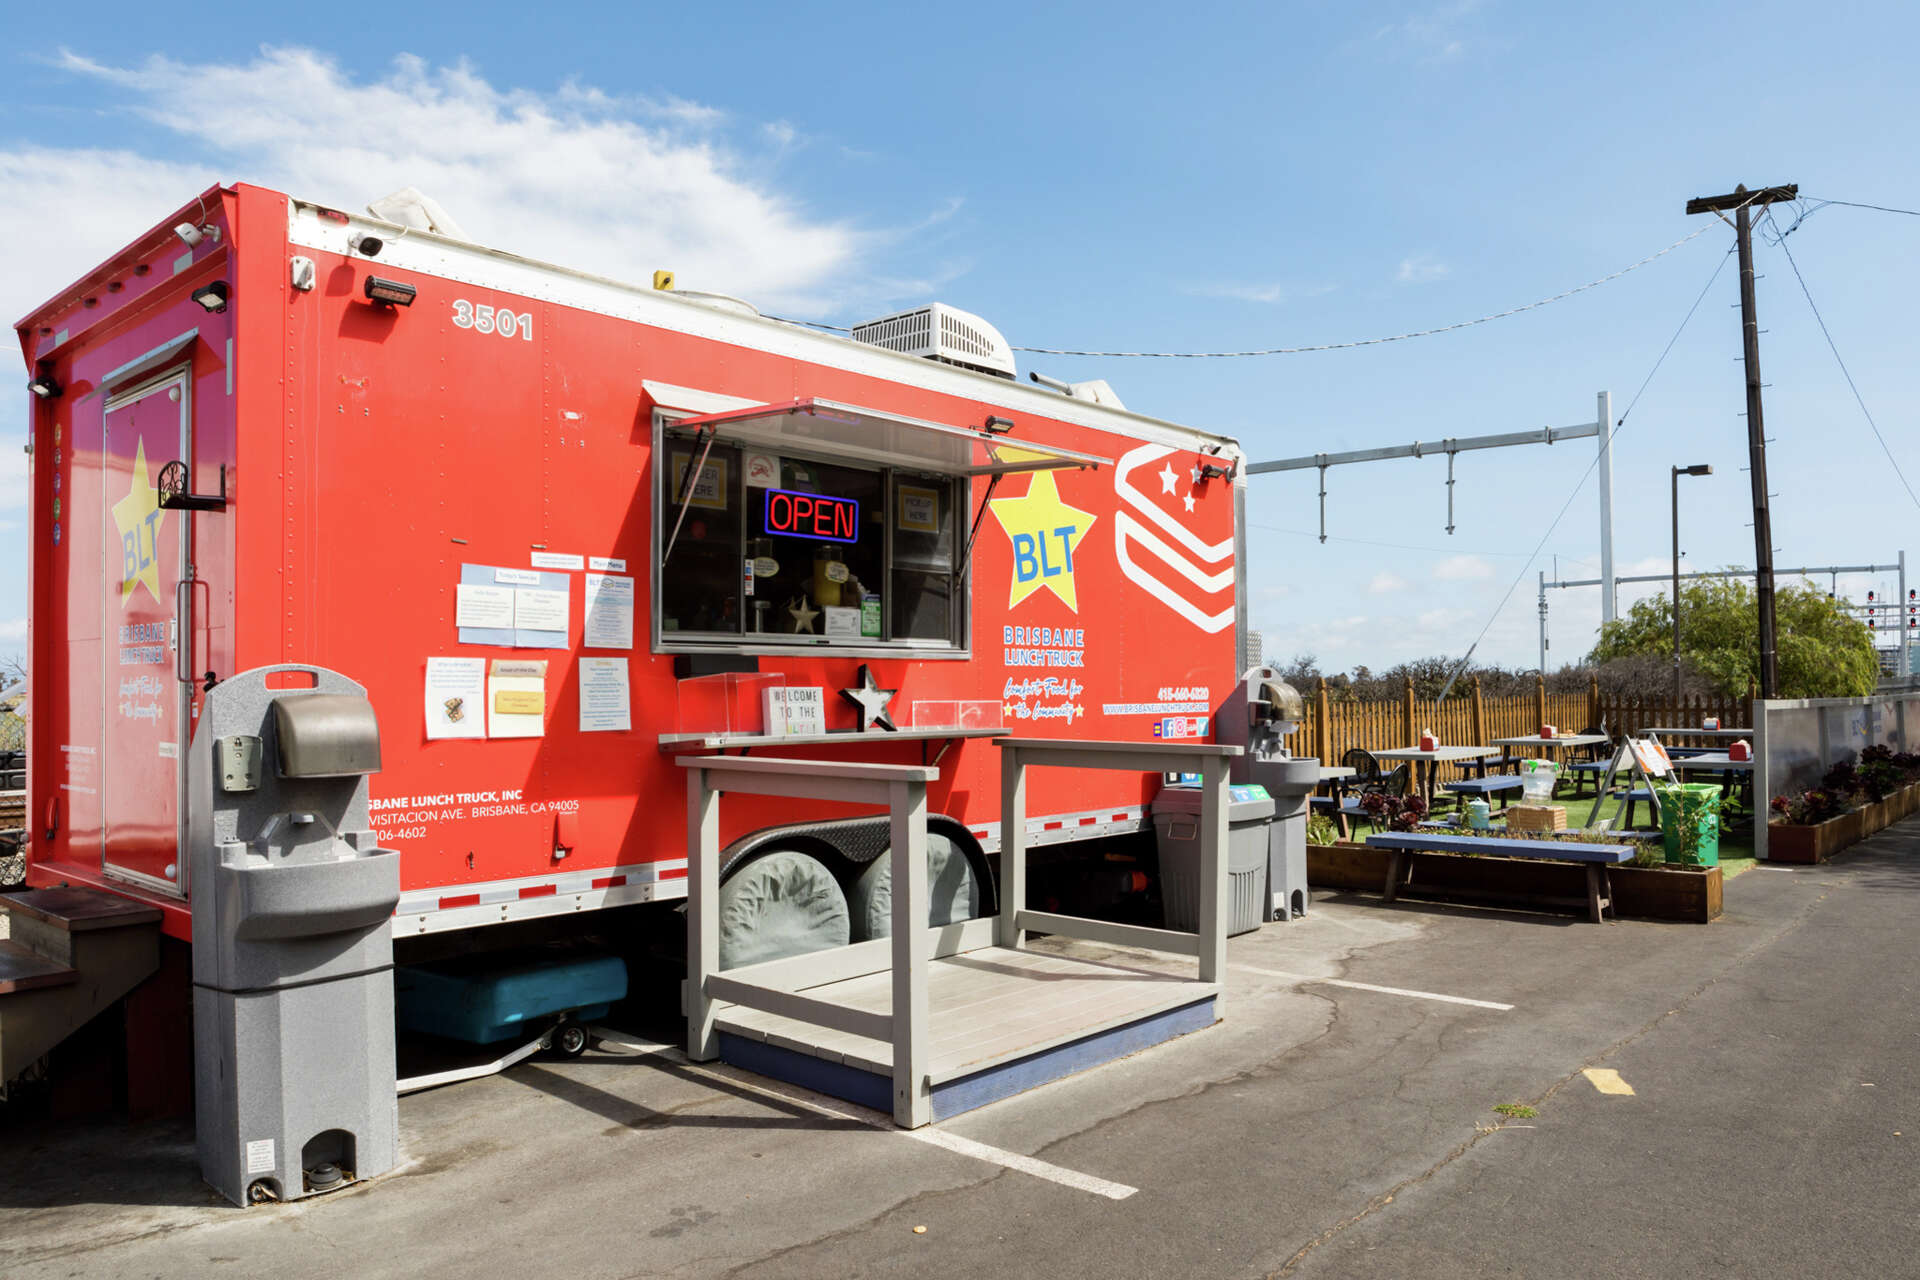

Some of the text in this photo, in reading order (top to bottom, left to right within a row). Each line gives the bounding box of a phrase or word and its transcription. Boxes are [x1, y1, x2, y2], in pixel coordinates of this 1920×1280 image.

[452, 299, 533, 341] 3501
[770, 494, 854, 538] OPEN
[122, 506, 160, 582] BLT
[1012, 525, 1077, 584] BLT
[1003, 626, 1085, 648] BRISBANE
[1004, 648, 1085, 668] LUNCH TRUCK
[774, 690, 817, 702] WELCOME
[1003, 677, 1084, 700] Comfort Food for
[779, 706, 816, 718] TO THE
[1032, 700, 1076, 725] Community
[368, 789, 523, 810] SBANE LUNCH TRUCK, INC
[368, 799, 580, 826] VISITACION AVE. BRISBANE, CA 94005
[376, 826, 427, 841] 06-4602
